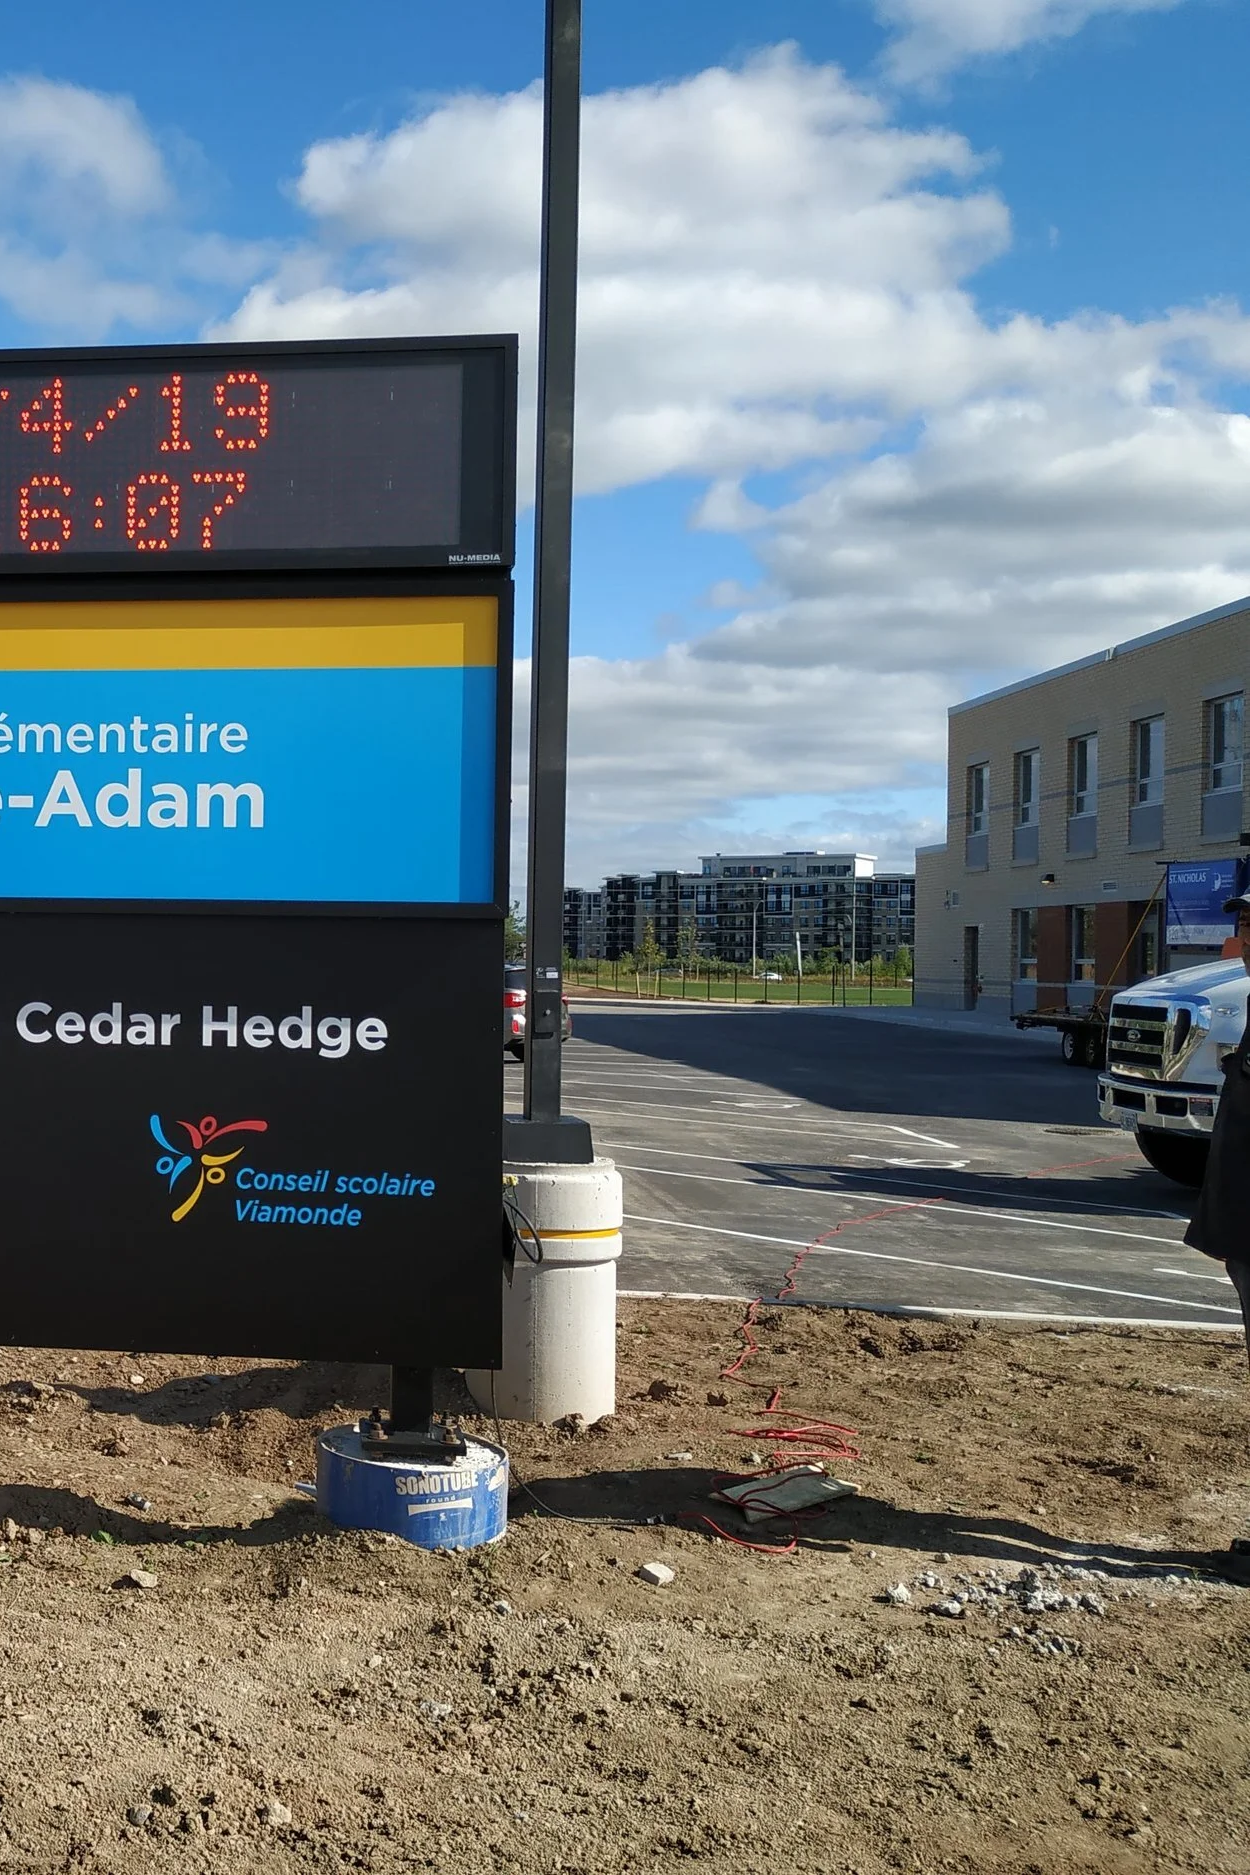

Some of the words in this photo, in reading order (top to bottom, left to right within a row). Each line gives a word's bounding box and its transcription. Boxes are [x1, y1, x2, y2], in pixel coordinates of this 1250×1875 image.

[448, 554, 501, 562] NU-MEDIA
[16, 1001, 181, 1046] Cedar
[202, 1005, 388, 1059] Hedge
[236, 1168, 329, 1193] Conseil
[336, 1172, 436, 1197] scolaire
[236, 1200, 362, 1227] Viamonde
[395, 1471, 478, 1496] SONOTUBE
[426, 1495, 456, 1503] round
